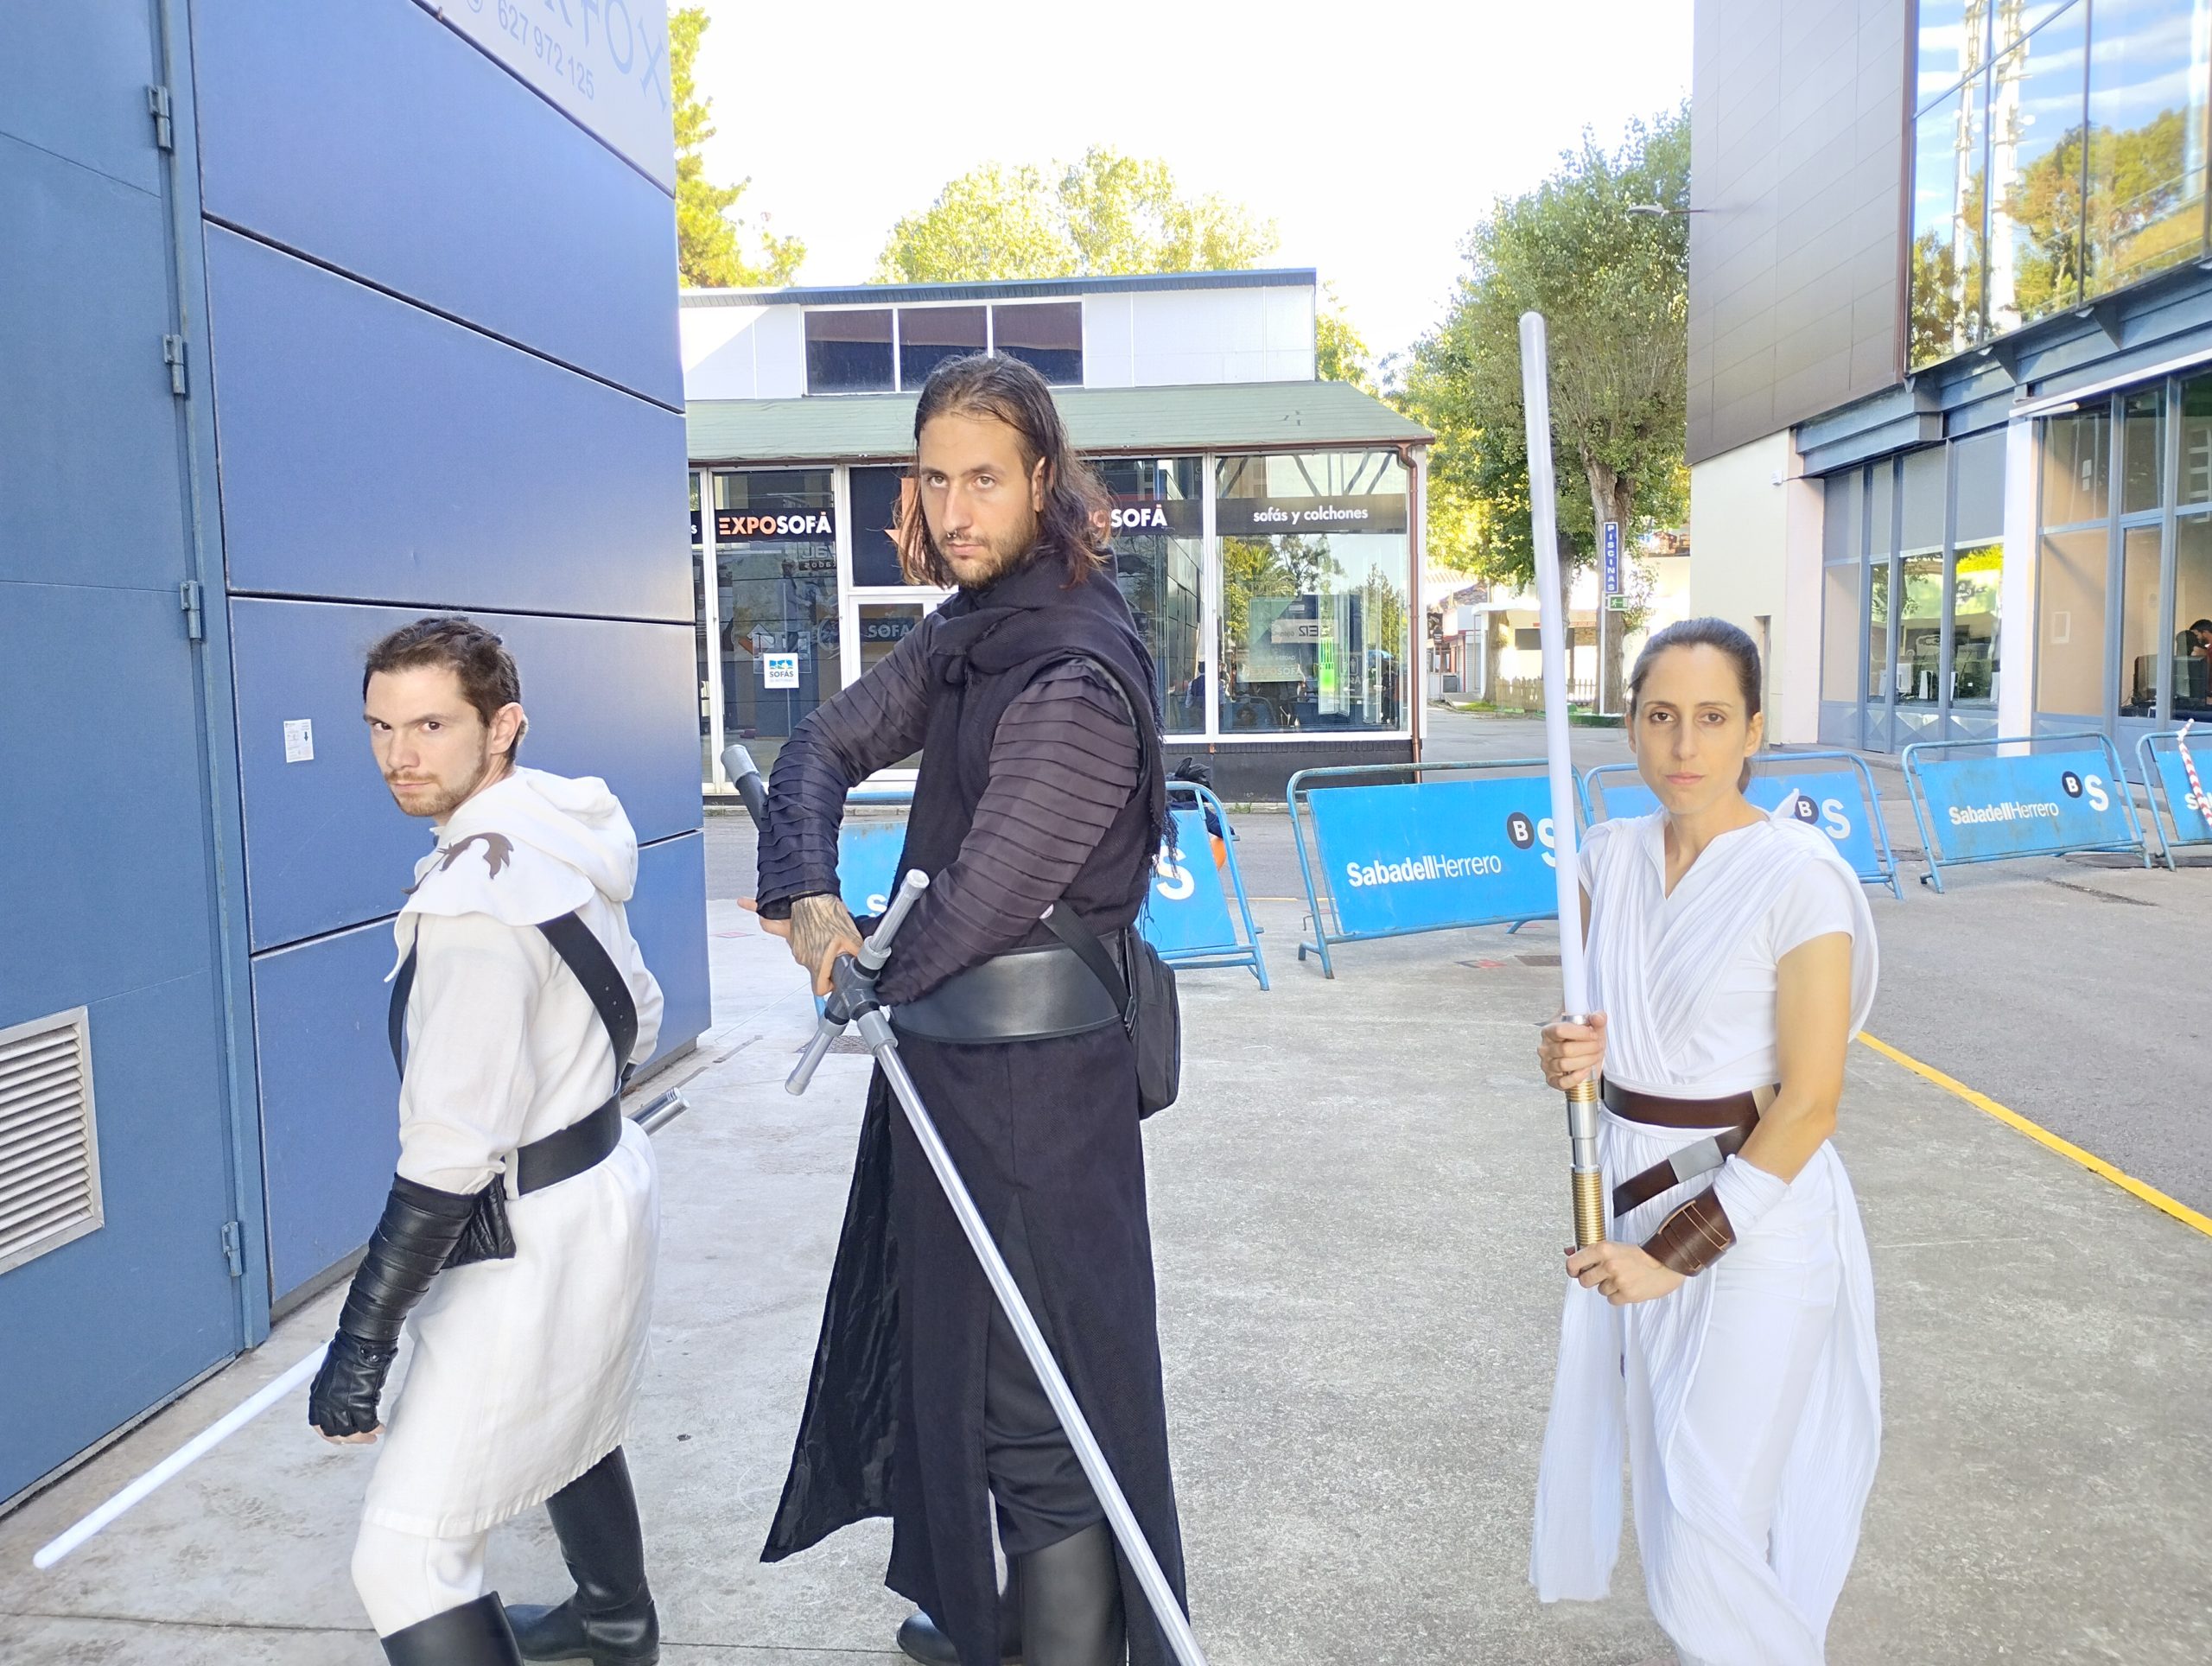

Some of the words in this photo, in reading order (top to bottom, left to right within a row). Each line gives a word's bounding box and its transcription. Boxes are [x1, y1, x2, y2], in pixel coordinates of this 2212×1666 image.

[498, 0, 528, 44] 627
[534, 26, 563, 76] 972
[568, 55, 594, 100] 125
[719, 512, 832, 535] EXPOSOFÁ
[1254, 506, 1288, 522] sofás
[1291, 512, 1300, 525] y
[1304, 506, 1369, 521] colchones
[1607, 525, 1616, 591] PISCINAS
[1949, 802, 2060, 825] SabadellHerrero
[1346, 854, 1502, 887] SabadellHerrero
